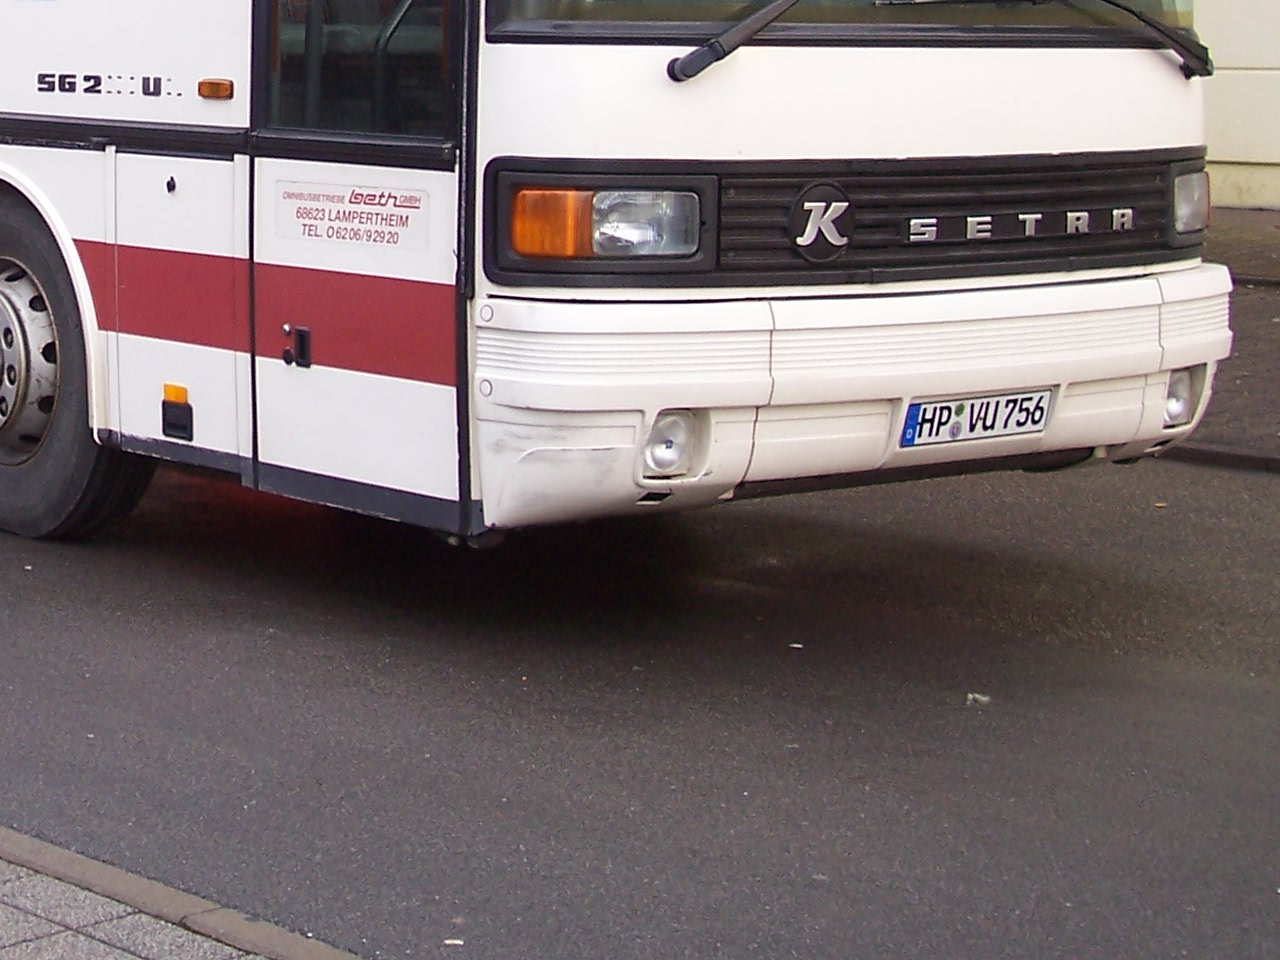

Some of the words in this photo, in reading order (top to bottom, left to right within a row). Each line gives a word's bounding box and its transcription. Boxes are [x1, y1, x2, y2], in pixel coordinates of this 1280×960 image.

[142, 77, 162, 97] U
[295, 206, 326, 221] 68623
[328, 209, 409, 228] LAMPERTHEIM
[796, 202, 849, 247] K
[909, 208, 1136, 242] SETRA
[302, 223, 323, 238] TEL.
[917, 405, 952, 438] HP
[968, 400, 1000, 433] VU
[1003, 395, 1045, 429] 756
[906, 430, 913, 439] D
